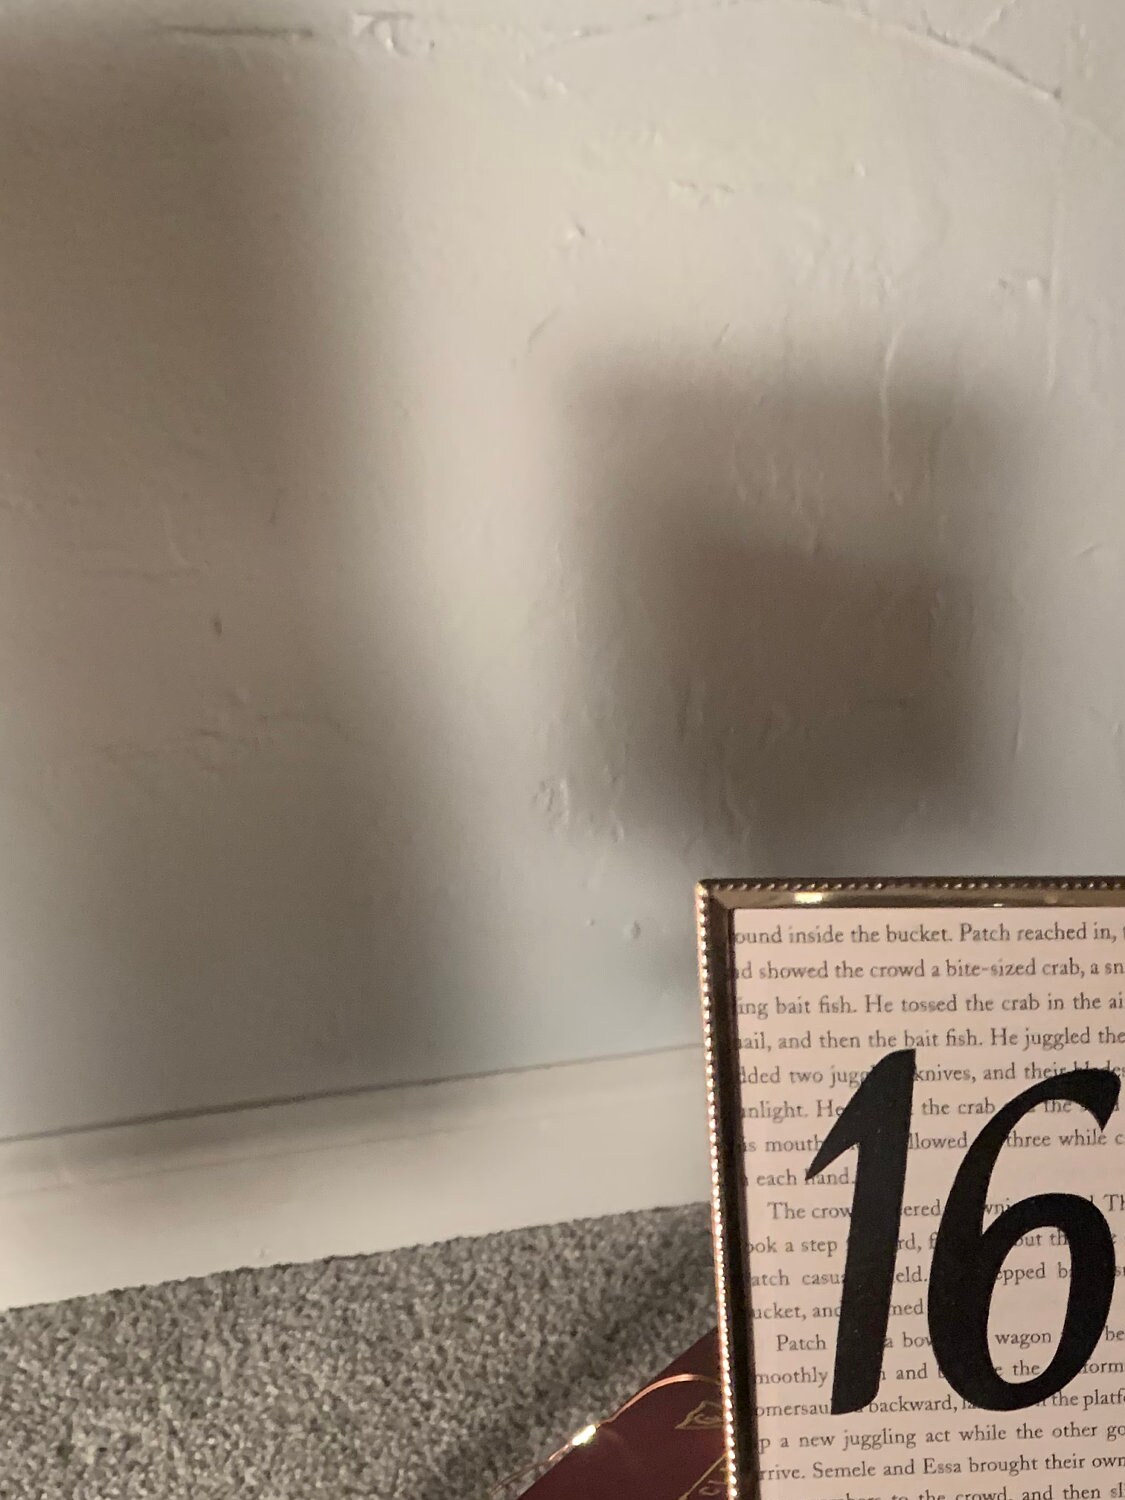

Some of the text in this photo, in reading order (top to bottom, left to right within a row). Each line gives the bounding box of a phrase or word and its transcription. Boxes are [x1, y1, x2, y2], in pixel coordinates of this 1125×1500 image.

[789, 925, 844, 943] inside
[851, 925, 880, 943] the
[886, 924, 953, 942] bucket.
[960, 922, 1010, 941] Patch
[1017, 922, 1087, 940] reached
[1093, 922, 1117, 943] in,
[759, 960, 829, 978] showed
[835, 960, 864, 978] the
[870, 959, 925, 977] crowd
[932, 967, 940, 977] a
[946, 958, 1036, 976] bite-sized
[1042, 957, 1085, 979] crab,
[1090, 964, 1099, 975] a
[776, 996, 811, 1014] bait
[819, 995, 857, 1014] fish.
[865, 994, 893, 1013] He
[901, 994, 957, 1013] tossed
[966, 994, 994, 1011] the
[1002, 993, 1040, 1011] crab
[1048, 993, 1064, 1010] in
[1073, 993, 1102, 1010] the
[779, 1031, 811, 1049] and
[819, 1030, 860, 1048] then
[869, 1030, 897, 1047] the
[905, 1030, 940, 1047] bait
[946, 1028, 983, 1046] fish.
[991, 1028, 1018, 1045] He
[1023, 1027, 1090, 1050] juggled
[790, 1070, 823, 1083] two
[983, 1062, 1015, 1079] and
[922, 1099, 950, 1115] the
[958, 1097, 995, 1115] crab
[1058, 1129, 1107, 1146] while
[756, 1168, 797, 1186] each
[767, 1201, 805, 1220] The
[811, 1206, 852, 1219] crow
[805, 1048, 1121, 1415] 16
[785, 1242, 793, 1252] a
[801, 1240, 837, 1257] step
[776, 1334, 826, 1352] Patch
[995, 1332, 1051, 1349] wagon
[896, 1363, 927, 1380] and
[1012, 1360, 1040, 1377] the
[869, 1394, 958, 1413] backward,
[1051, 1390, 1078, 1406] the
[780, 1437, 789, 1448] a
[799, 1435, 835, 1448] new
[842, 1428, 916, 1451] juggling
[925, 1430, 950, 1443] act
[959, 1424, 1007, 1441] while
[1016, 1423, 1044, 1439] the
[1052, 1421, 1098, 1437] other
[812, 1461, 876, 1479] Semele
[883, 1459, 915, 1476] and
[923, 1458, 962, 1475] Essa
[969, 1454, 1038, 1476] brought
[1045, 1453, 1086, 1470] their
[1062, 1483, 1101, 1500] then
